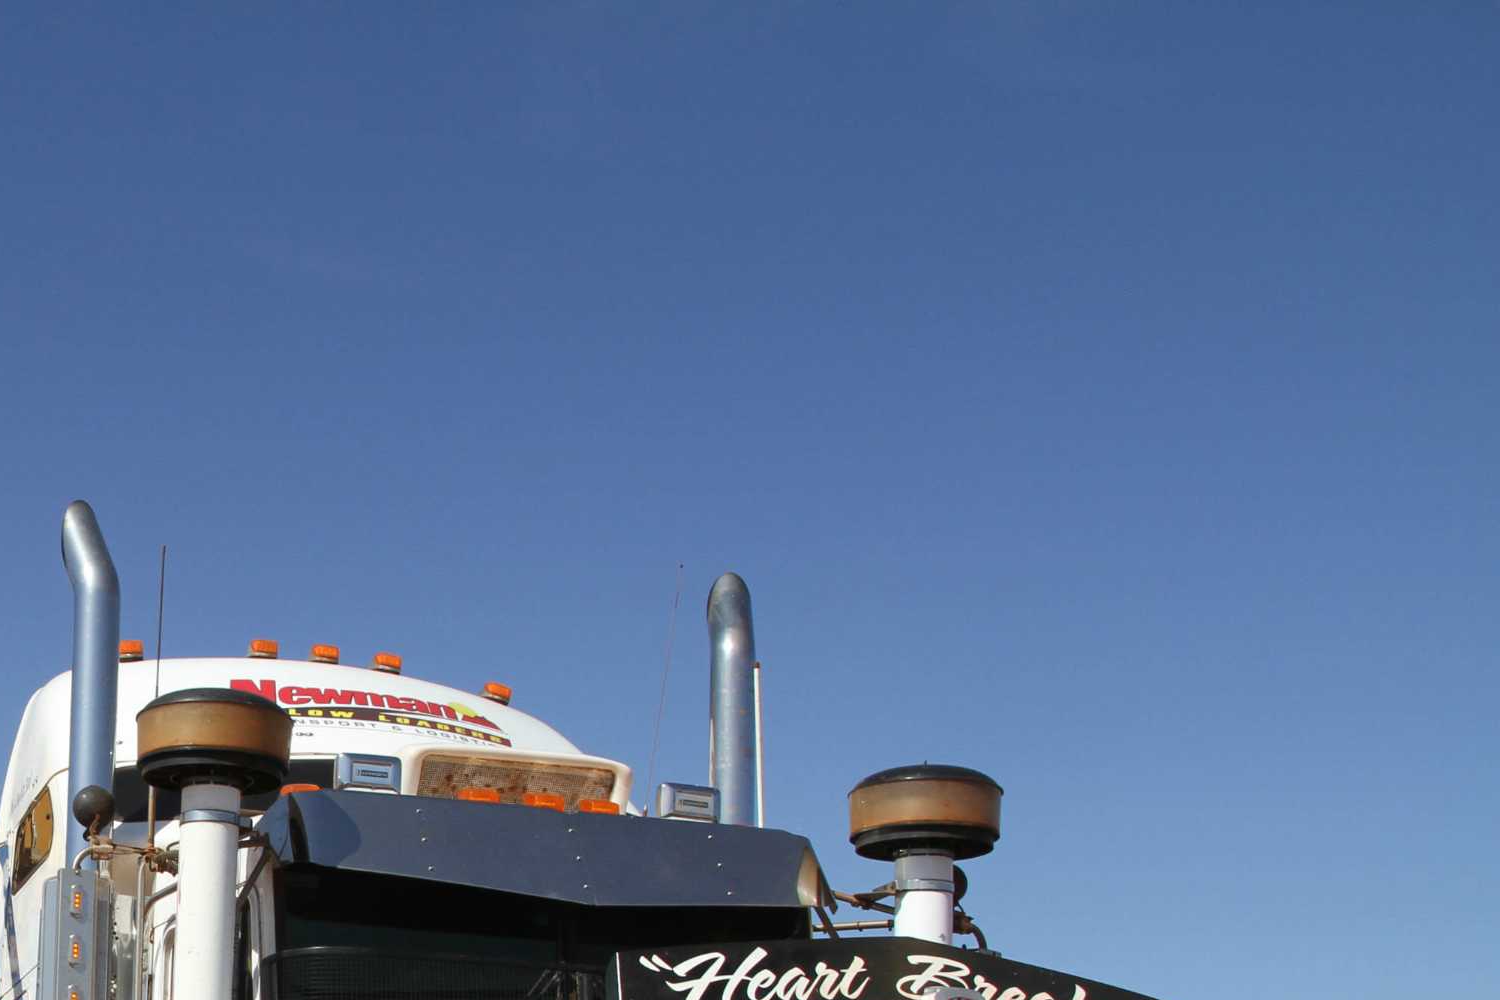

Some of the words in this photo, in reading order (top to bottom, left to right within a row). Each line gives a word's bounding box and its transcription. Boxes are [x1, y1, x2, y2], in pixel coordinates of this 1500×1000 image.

[230, 679, 457, 721] Newman
[288, 708, 355, 718] LOW
[377, 714, 502, 744] LOADERS
